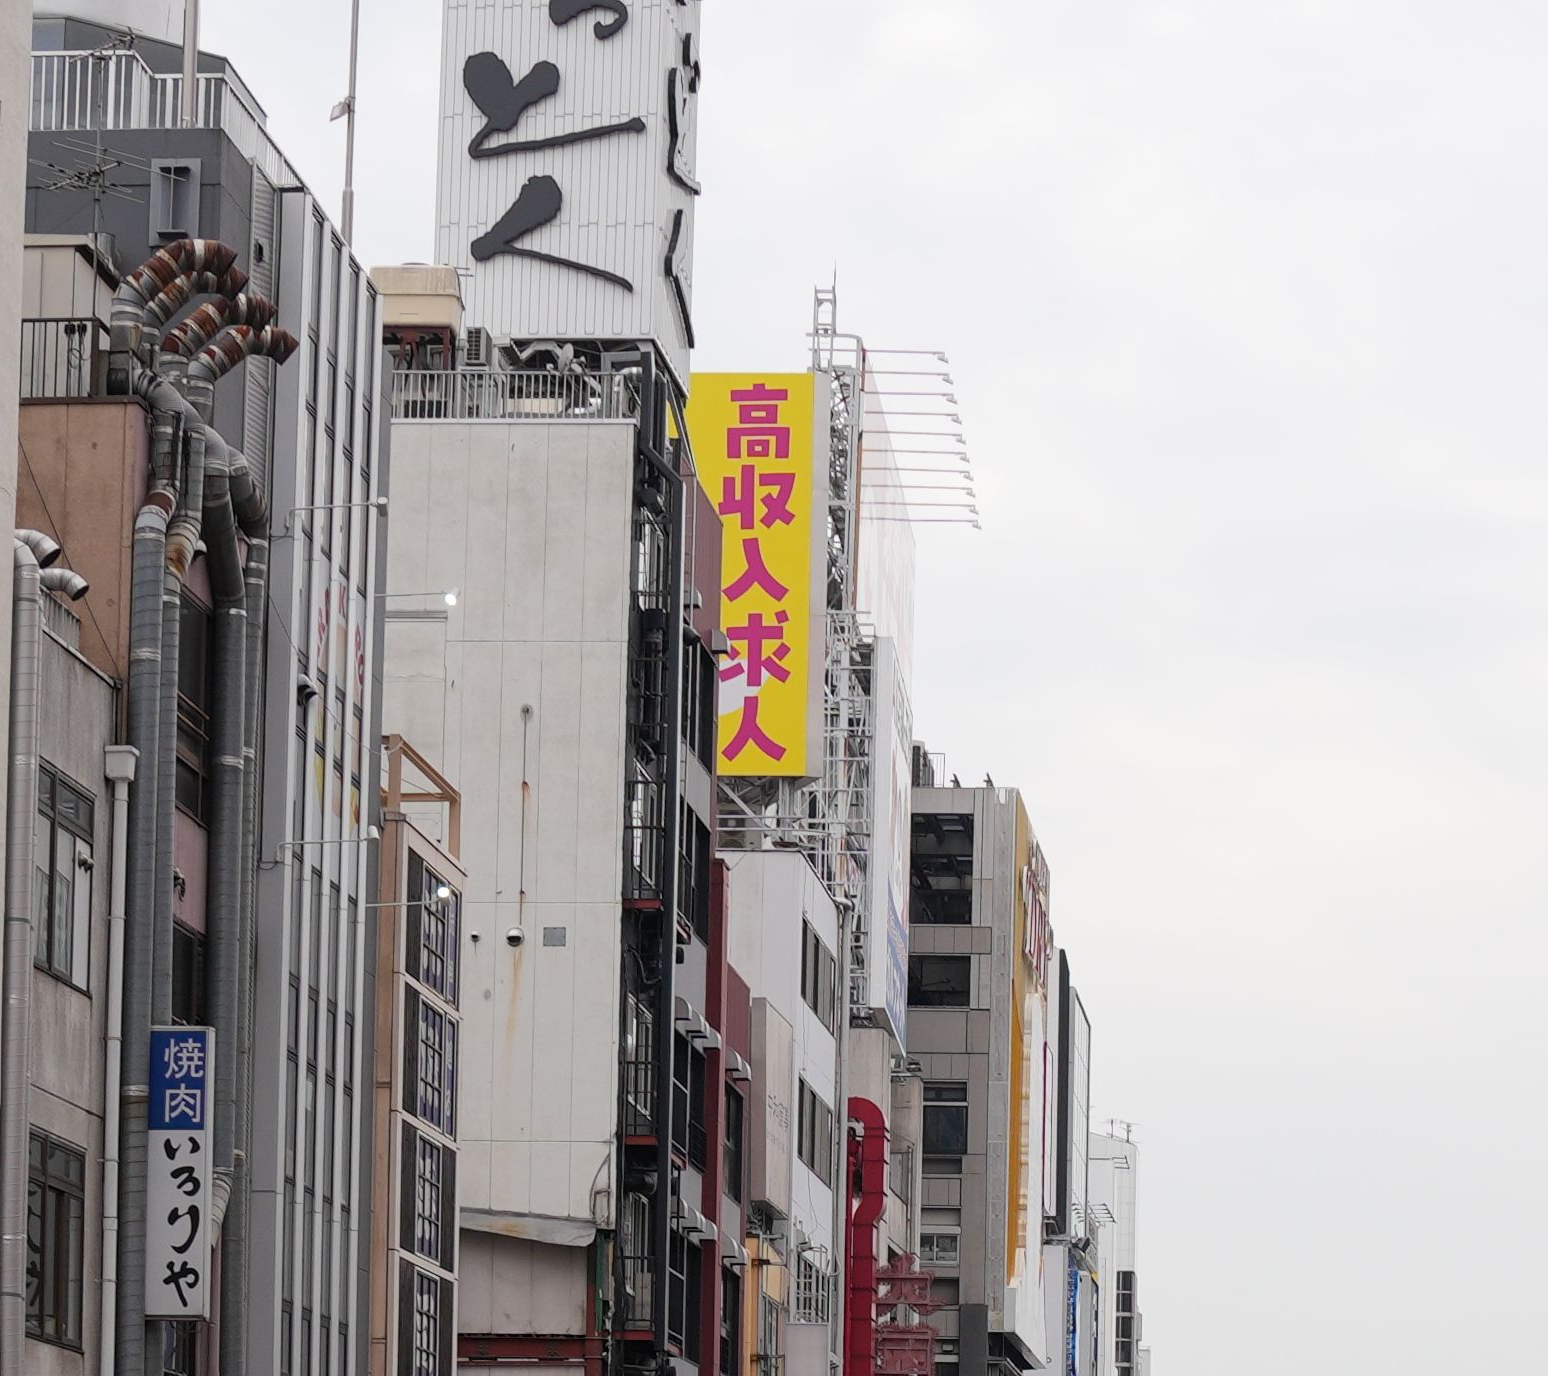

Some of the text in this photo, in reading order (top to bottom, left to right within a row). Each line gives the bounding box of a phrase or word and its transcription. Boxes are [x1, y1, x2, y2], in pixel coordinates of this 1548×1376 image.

[719, 382, 796, 764] 高収入求人
[162, 1038, 205, 1312] 焼肉 いろりや
